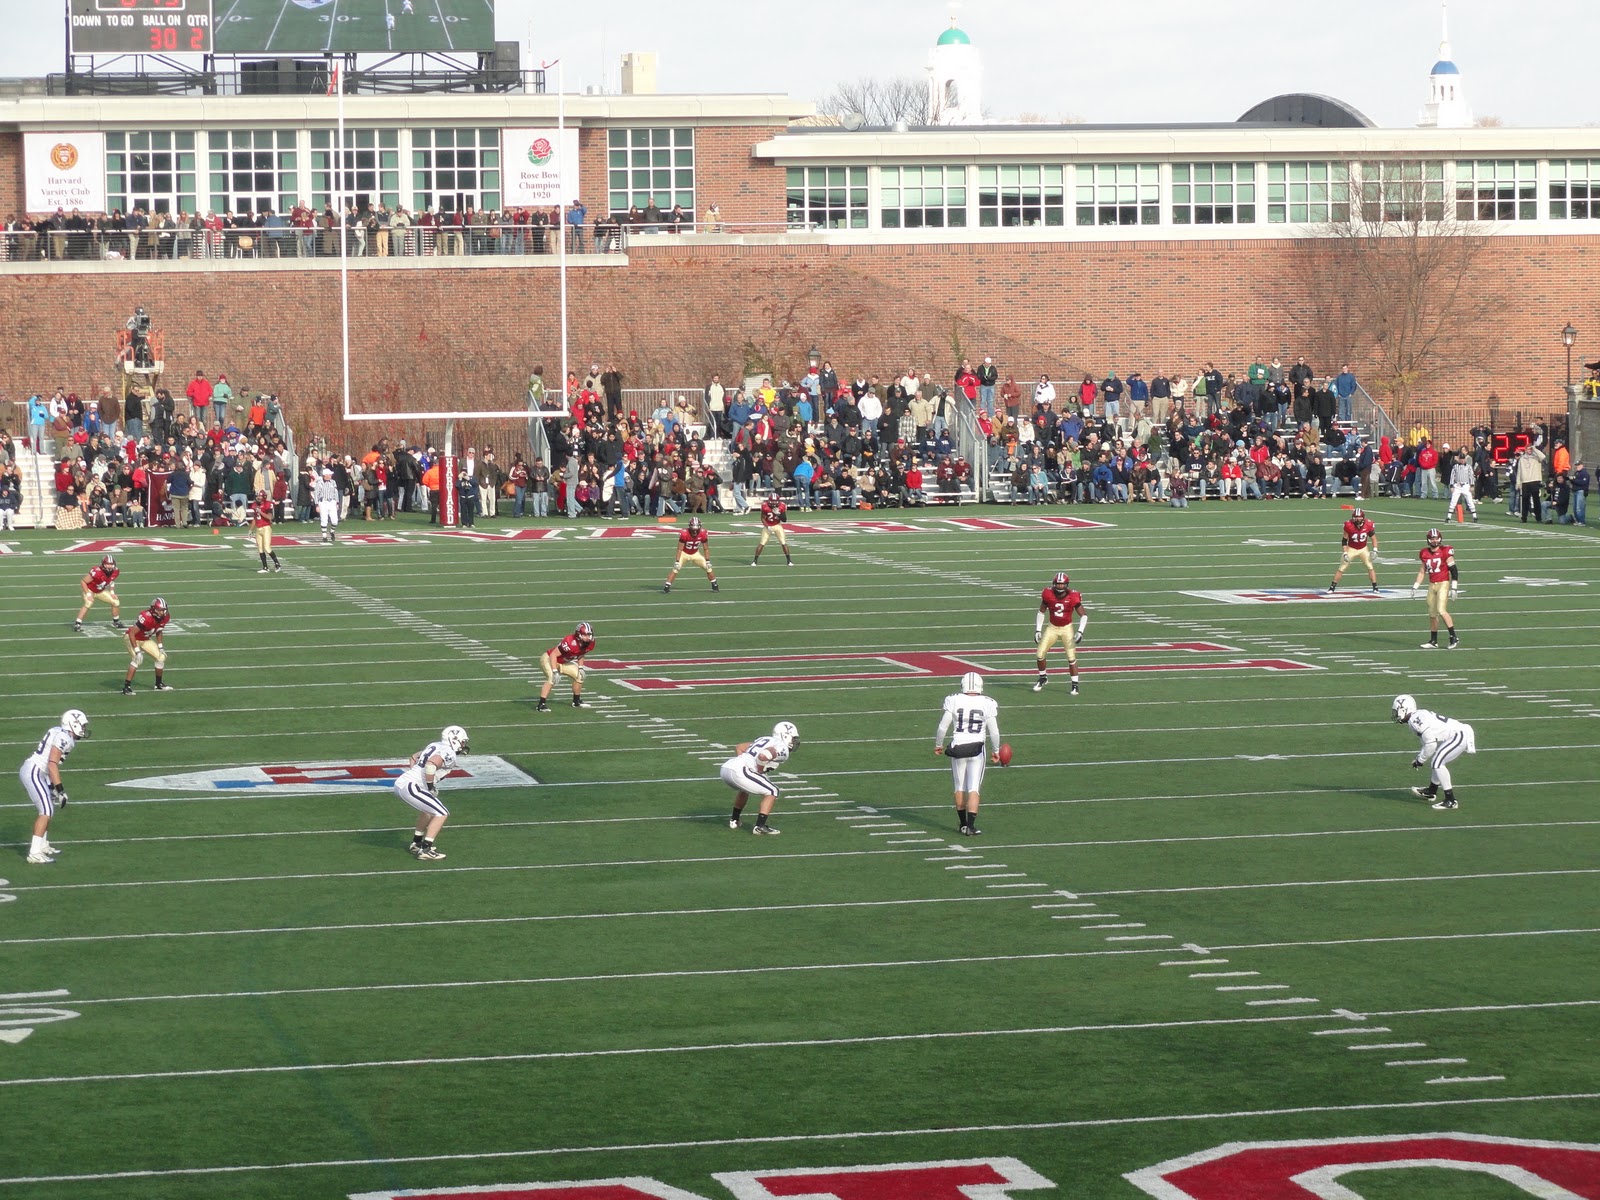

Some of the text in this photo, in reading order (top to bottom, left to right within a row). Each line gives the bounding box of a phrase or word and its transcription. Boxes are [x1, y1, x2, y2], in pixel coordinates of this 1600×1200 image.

[73, 15, 101, 26] DOWN
[106, 15, 134, 26] TO GO
[143, 15, 180, 26] BALL ON
[187, 15, 208, 26] QTR
[150, 28, 177, 49] 30
[190, 28, 203, 49] 2
[520, 171, 561, 179] Rose Bow
[48, 177, 82, 185] Harvard
[41, 188, 68, 197] Varsity
[533, 191, 551, 199] 1920
[48, 198, 83, 206] Est. 1886
[446, 457, 454, 525] HARVARD
[1425, 558, 1441, 573] 47
[1053, 603, 1065, 617] 2
[956, 707, 984, 734] 16
